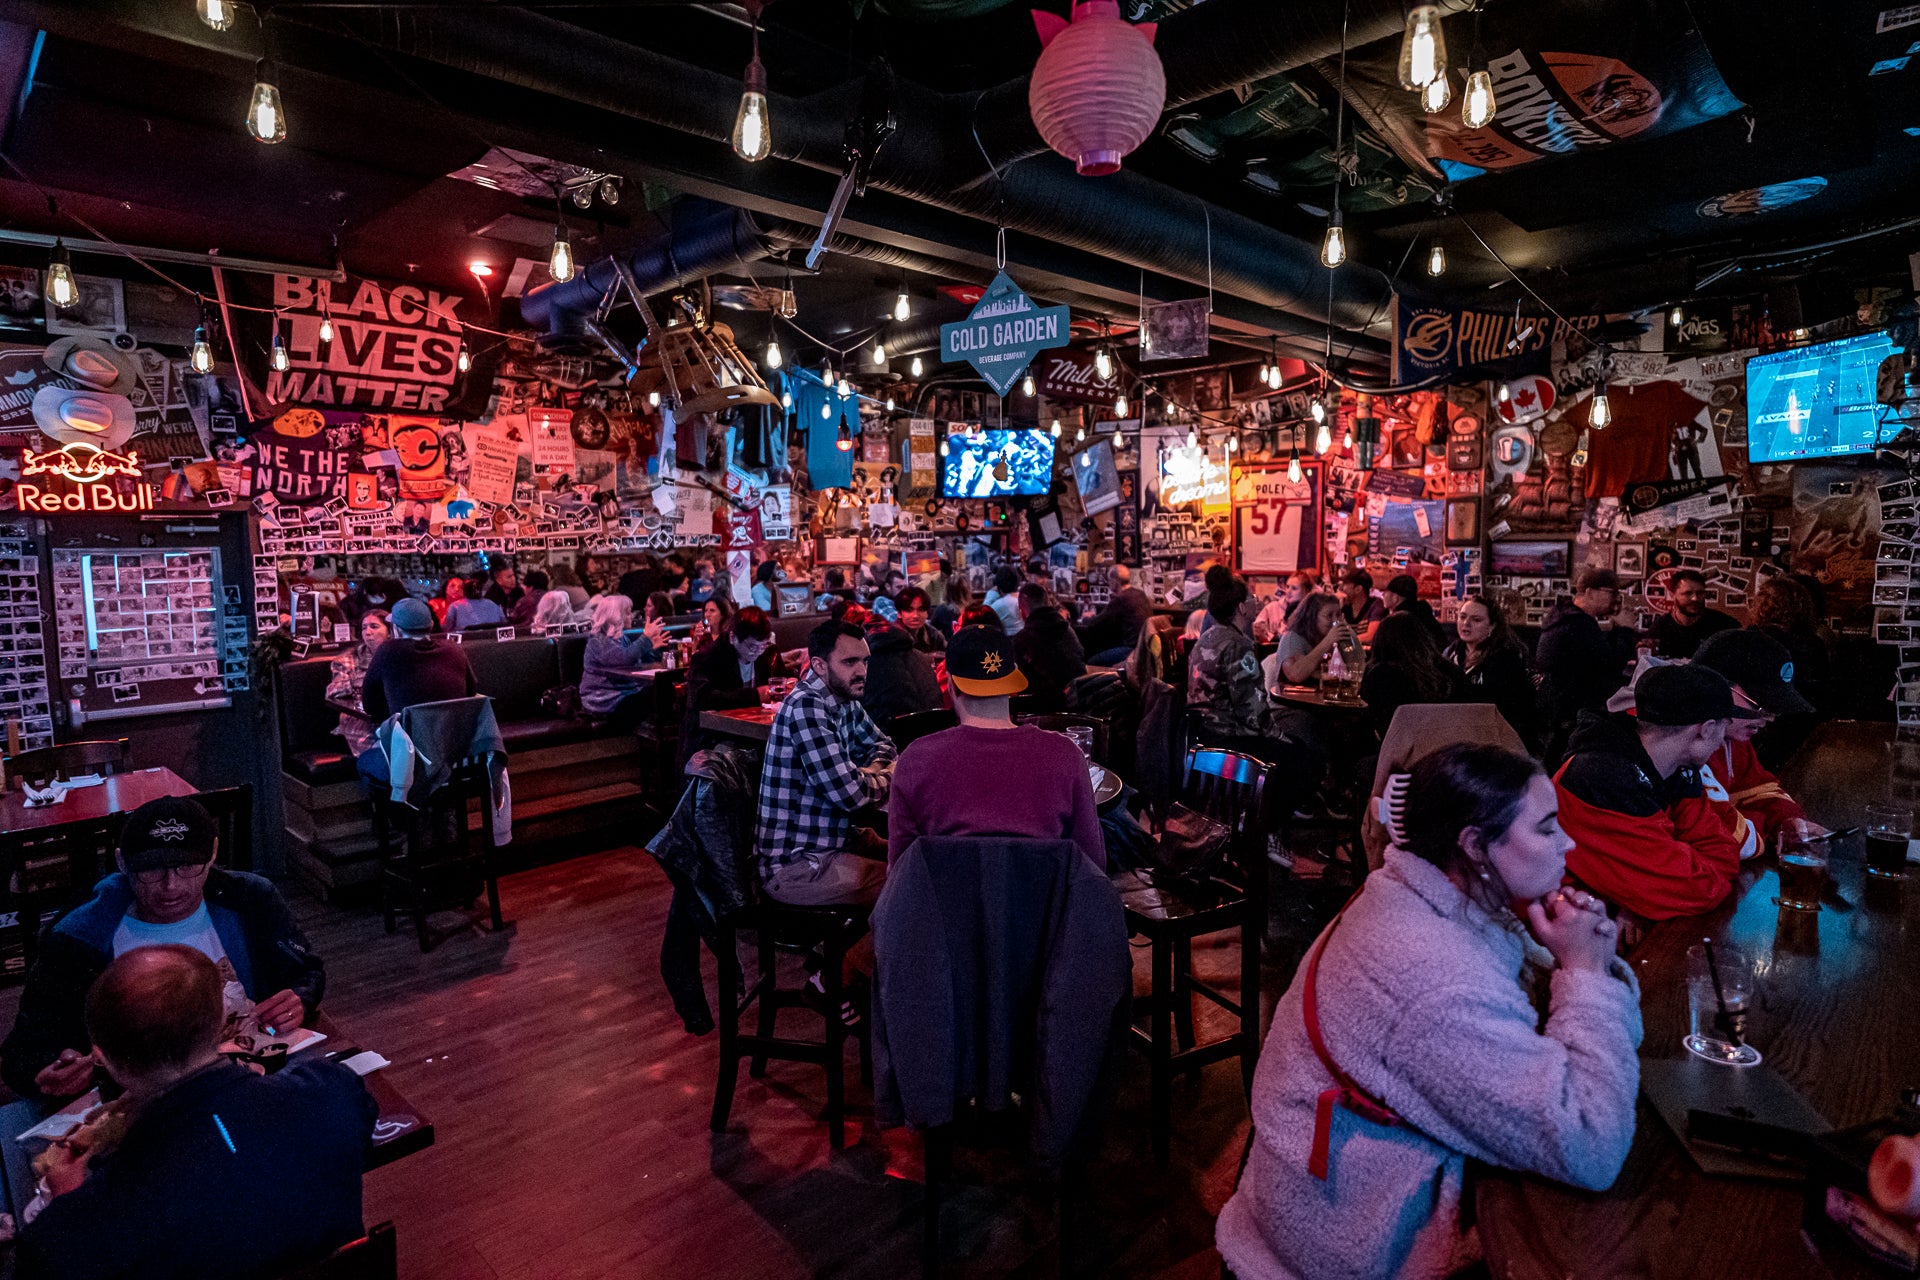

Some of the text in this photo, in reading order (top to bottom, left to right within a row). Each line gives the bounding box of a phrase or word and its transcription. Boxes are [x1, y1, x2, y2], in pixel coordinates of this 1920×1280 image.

[273, 273, 464, 333] BLACK
[277, 316, 455, 377] LIVES
[950, 313, 1058, 353] COLD GARDEN
[1456, 310, 1549, 367] PHILLIPS
[1677, 319, 1720, 344] KINGS
[978, 350, 1026, 364] BEVERAGE COMPANY
[1049, 358, 1092, 385] Mill
[1701, 361, 1725, 377] NRA
[266, 371, 450, 412] MATTER
[1045, 382, 1116, 400] BREWERY
[258, 440, 350, 474] WE THE
[17, 482, 154, 512] Red Bull
[256, 467, 348, 497] NORTH
[1662, 480, 1708, 495] ANNEX
[349, 512, 393, 522] TEQUILA
[1250, 498, 1288, 535] 57
